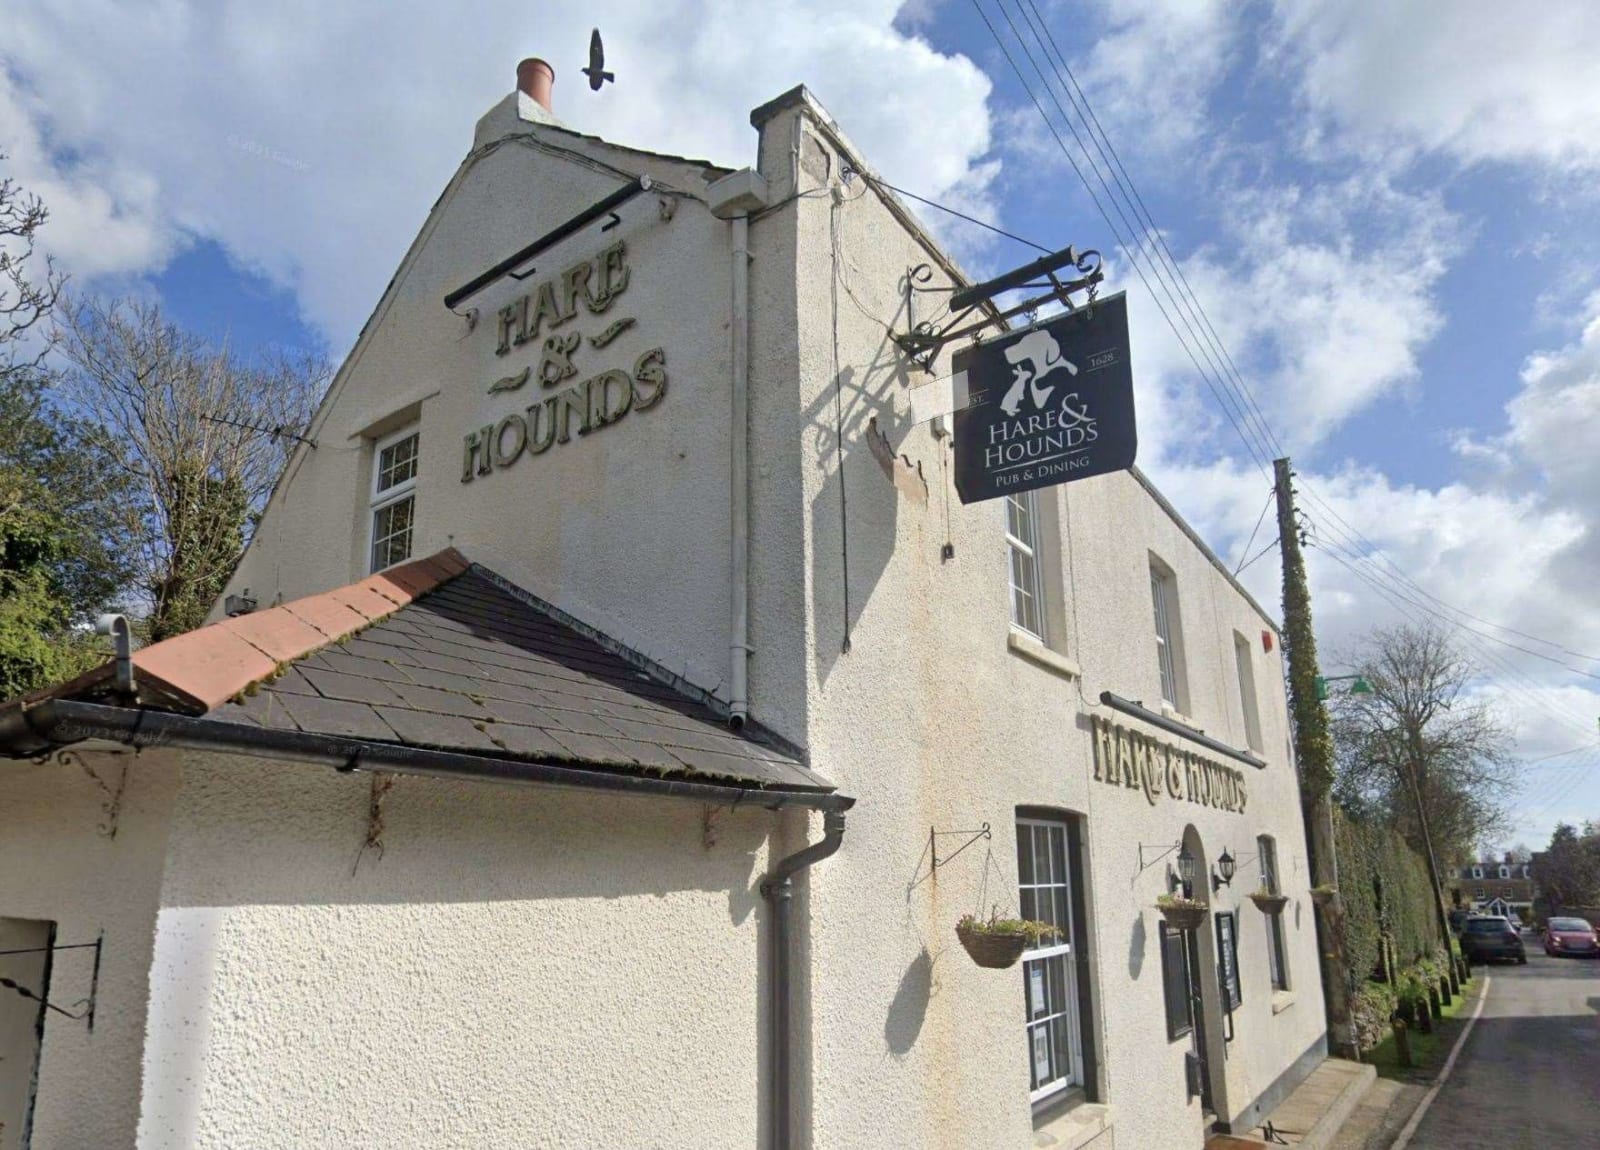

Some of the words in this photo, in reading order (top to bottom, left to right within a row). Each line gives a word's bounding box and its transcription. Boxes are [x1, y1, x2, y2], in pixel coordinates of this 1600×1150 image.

[495, 239, 632, 355] HARE
[538, 331, 581, 389] &
[1091, 353, 1114, 367] 1628
[460, 347, 667, 483] HOUNDS
[985, 421, 1098, 468] HOUNDS
[996, 474, 1020, 487] PUB
[1023, 469, 1034, 480] &
[1038, 456, 1090, 478] DINING
[1091, 714, 1162, 806] HARE
[1184, 751, 1248, 814] HOUNDS
